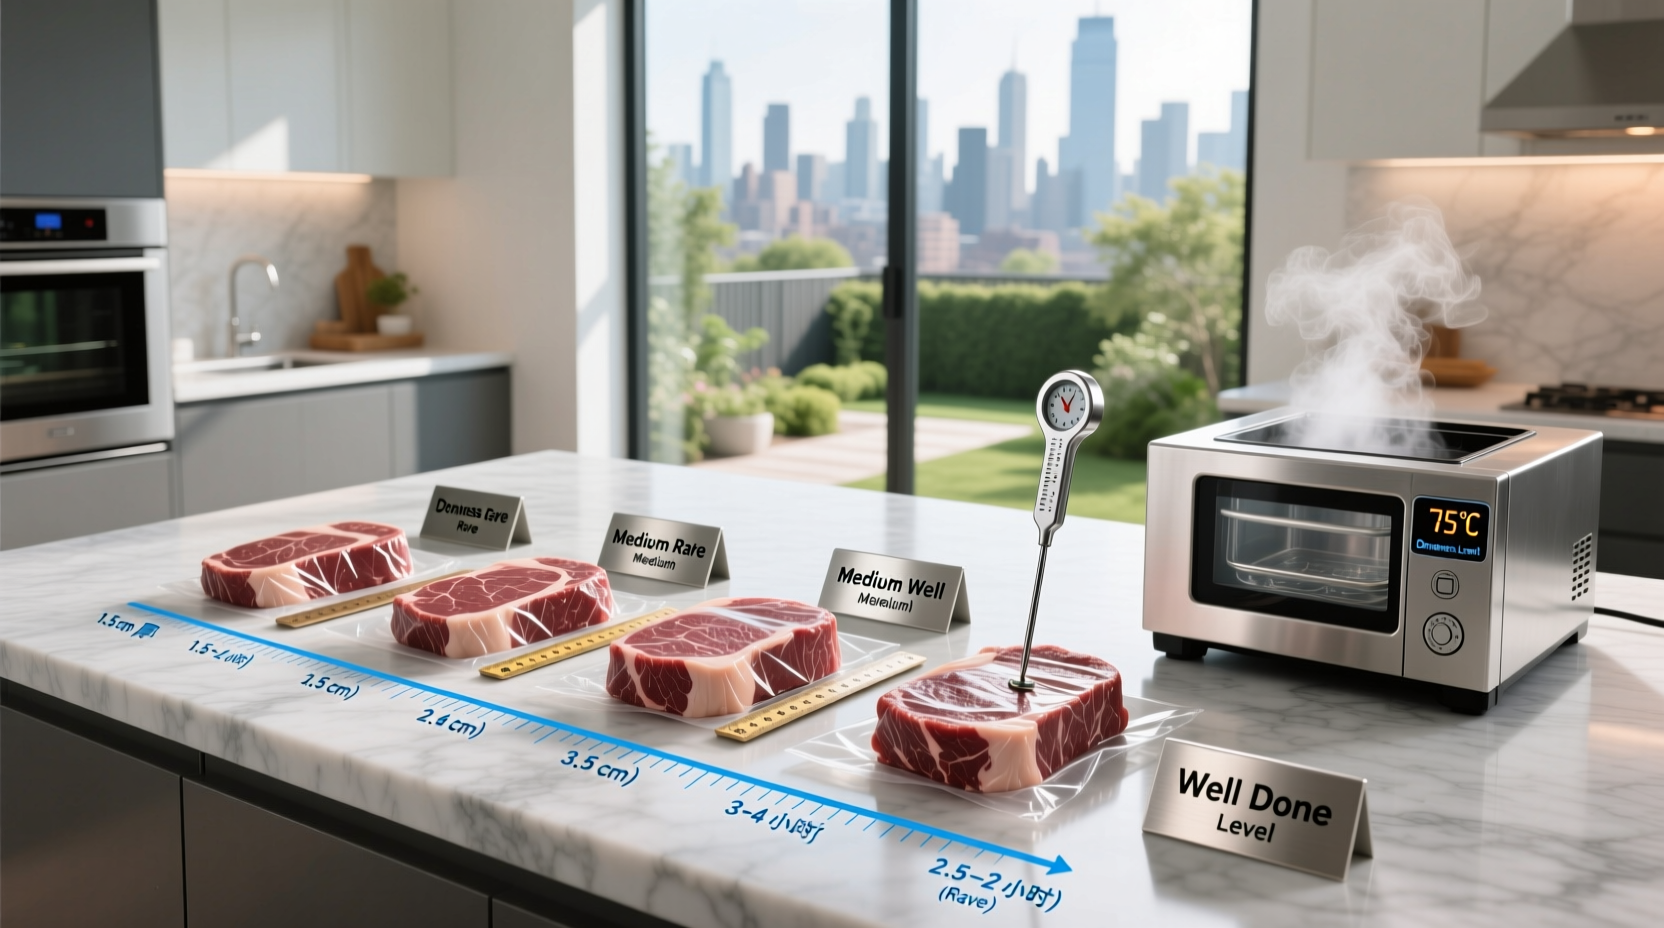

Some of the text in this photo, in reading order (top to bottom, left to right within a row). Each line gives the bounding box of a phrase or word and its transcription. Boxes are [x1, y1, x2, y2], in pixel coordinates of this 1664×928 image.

[612, 528, 670, 552] Medium
[837, 566, 946, 600] Medium Well
[1179, 767, 1332, 827] Well Done
[1216, 813, 1276, 843] Level
